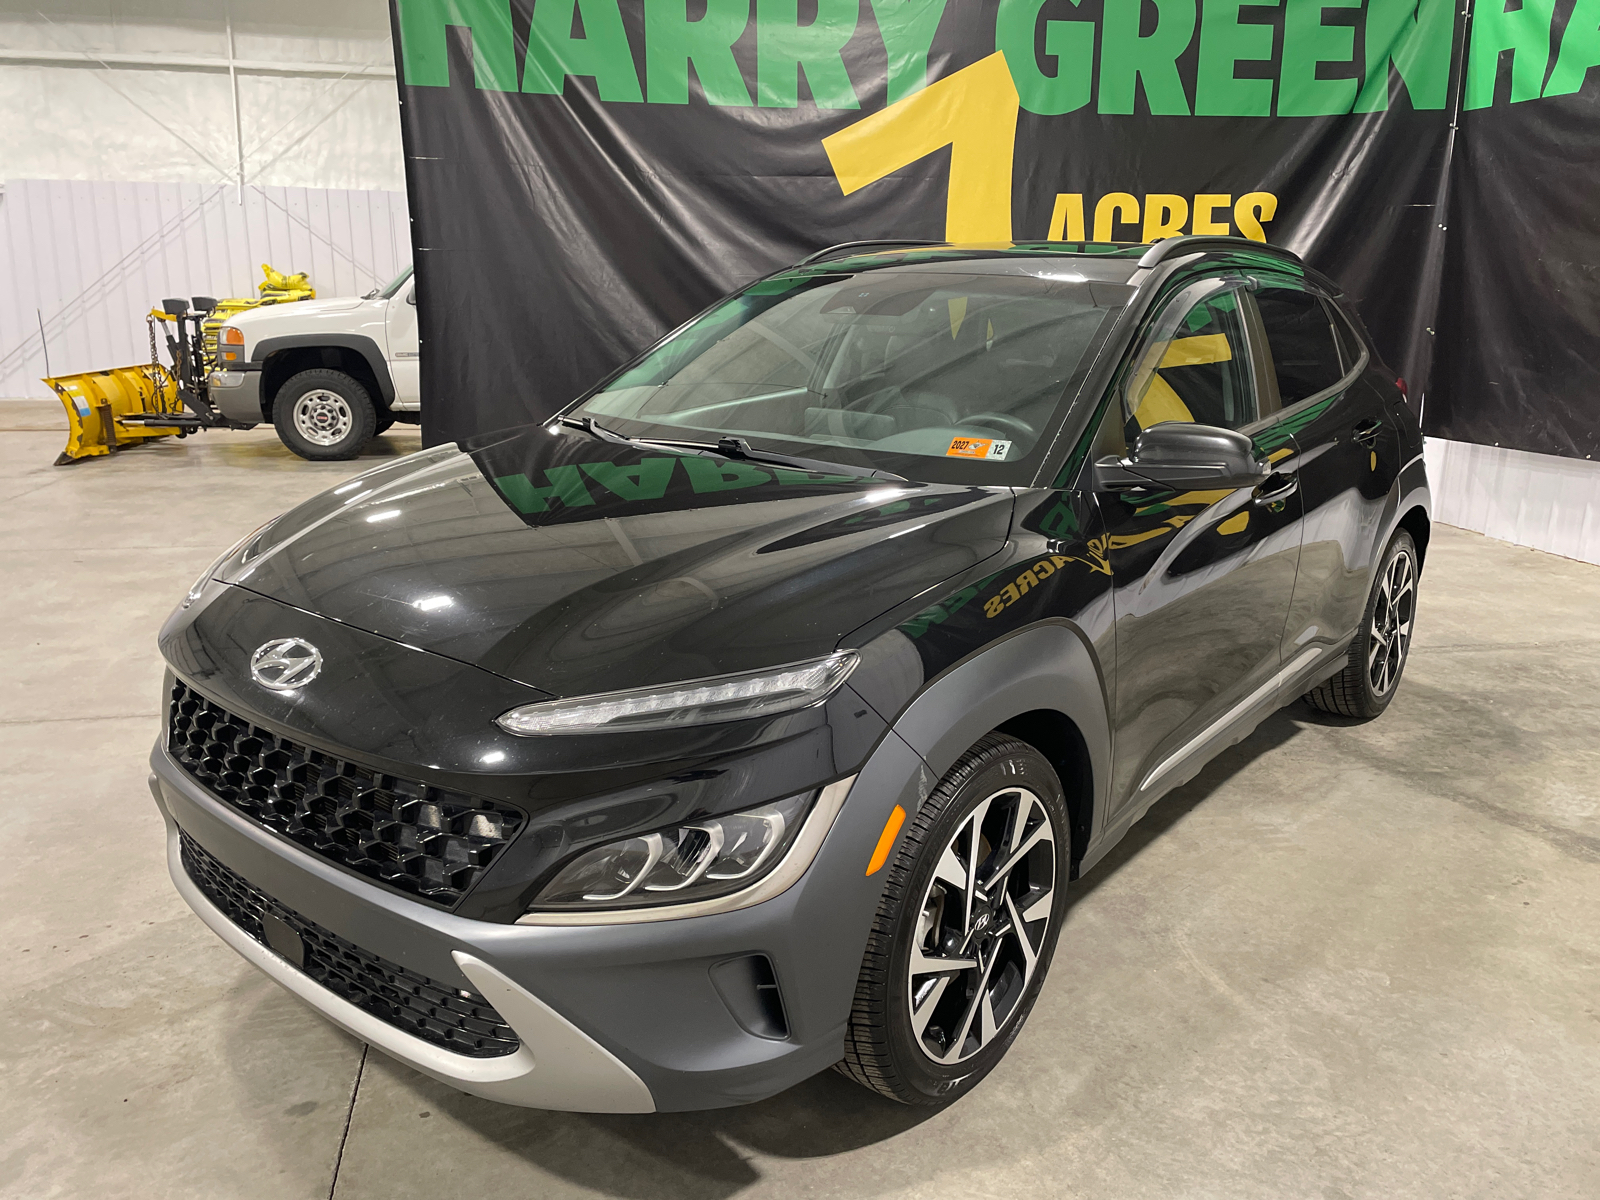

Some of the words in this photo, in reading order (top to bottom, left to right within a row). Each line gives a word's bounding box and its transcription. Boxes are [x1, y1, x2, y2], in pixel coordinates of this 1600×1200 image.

[396, 0, 950, 110] HARRY
[995, 0, 1457, 117] GREEN
[1046, 191, 1278, 244] ACRES
[951, 440, 969, 450] 2027
[993, 444, 1004, 455] 12
